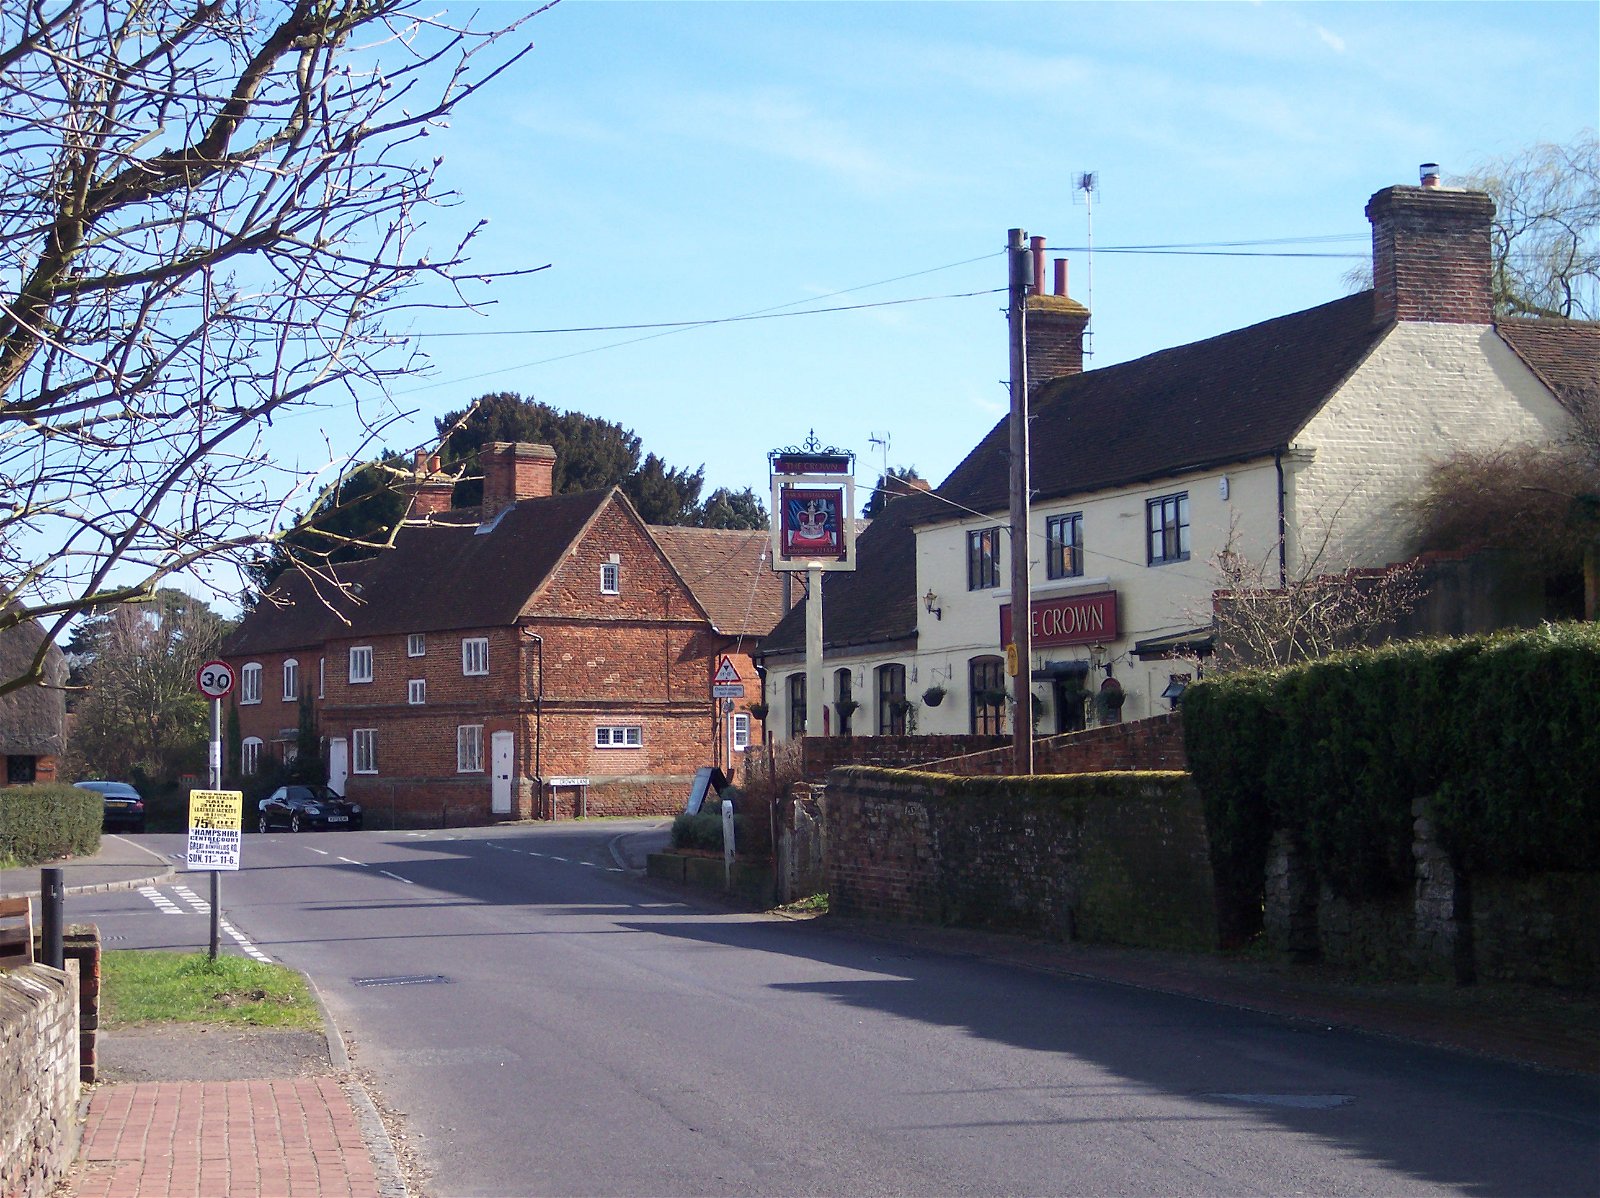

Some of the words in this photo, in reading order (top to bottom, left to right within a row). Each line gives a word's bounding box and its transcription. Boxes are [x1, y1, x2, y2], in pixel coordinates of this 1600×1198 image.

[785, 462, 802, 470] THE
[803, 462, 838, 471] CROWN
[1042, 603, 1103, 636] CROWN
[202, 671, 230, 689] 30
[194, 829, 238, 837] HAMPSHIRE
[190, 841, 204, 850] GREAT
[189, 854, 203, 863] SUN.
